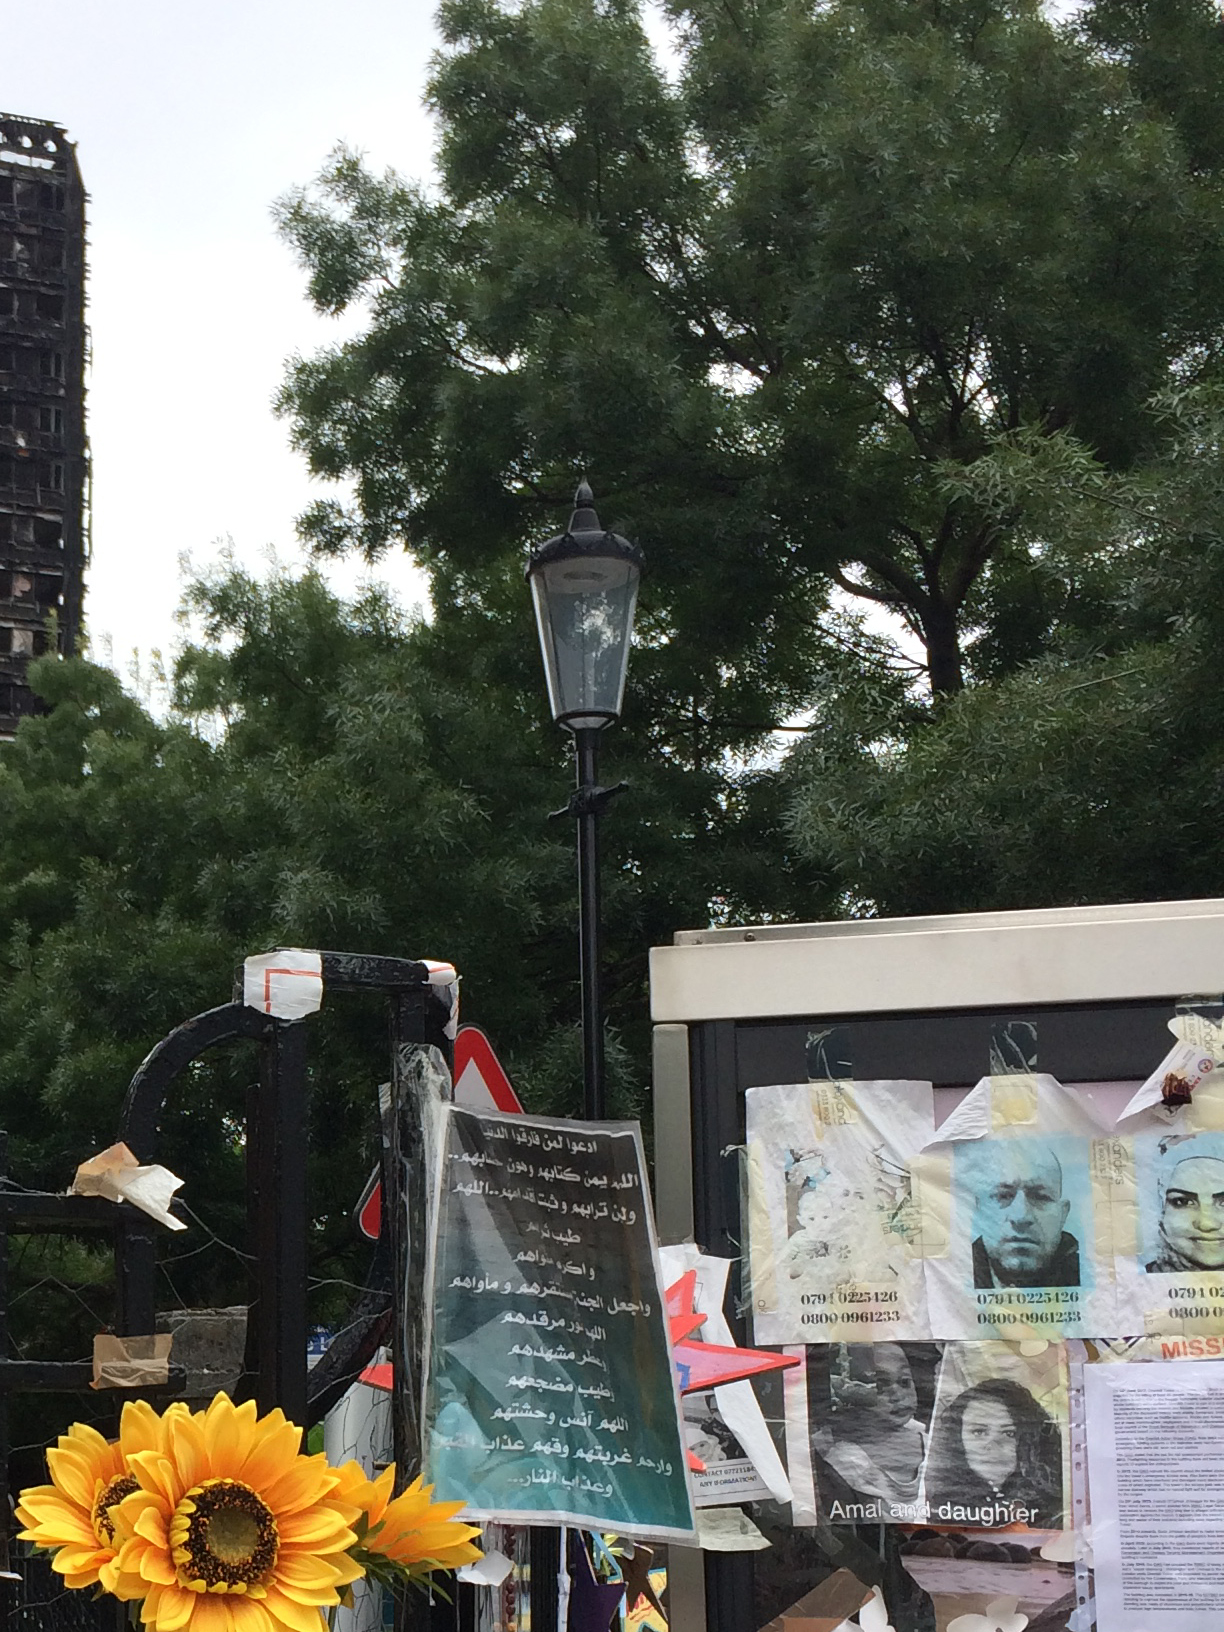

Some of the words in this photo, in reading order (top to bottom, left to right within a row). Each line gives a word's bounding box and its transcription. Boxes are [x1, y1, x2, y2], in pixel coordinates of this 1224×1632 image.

[511, 1127, 541, 1147] فارقوا
[542, 1133, 564, 1152] لمن
[565, 1136, 598, 1155] ادعوا
[537, 1164, 581, 1183] كتابهم
[583, 1170, 608, 1189] يمن
[551, 1228, 581, 1247] طيب
[607, 1297, 651, 1318] واجعل
[1168, 1306, 1210, 1319] 0800
[499, 1310, 566, 1331] مرقدهم
[801, 1312, 838, 1325] 0800
[840, 1310, 901, 1324] 0961233
[977, 1312, 1017, 1325] 0800
[1019, 1310, 1082, 1324] 0961233
[507, 1343, 576, 1363] مشهدهم
[1161, 1337, 1224, 1360] MISS
[505, 1375, 574, 1393] مضجعهم
[489, 1401, 556, 1426] وحشتهم
[558, 1409, 595, 1428] آنس
[595, 1415, 629, 1433] اللهم
[480, 1433, 526, 1455] عذاب
[529, 1437, 570, 1458] وقهم
[561, 1474, 614, 1498] وعذاب
[830, 1498, 882, 1520] Amal
[889, 1500, 930, 1519] and
[938, 1501, 1039, 1527] daughter
